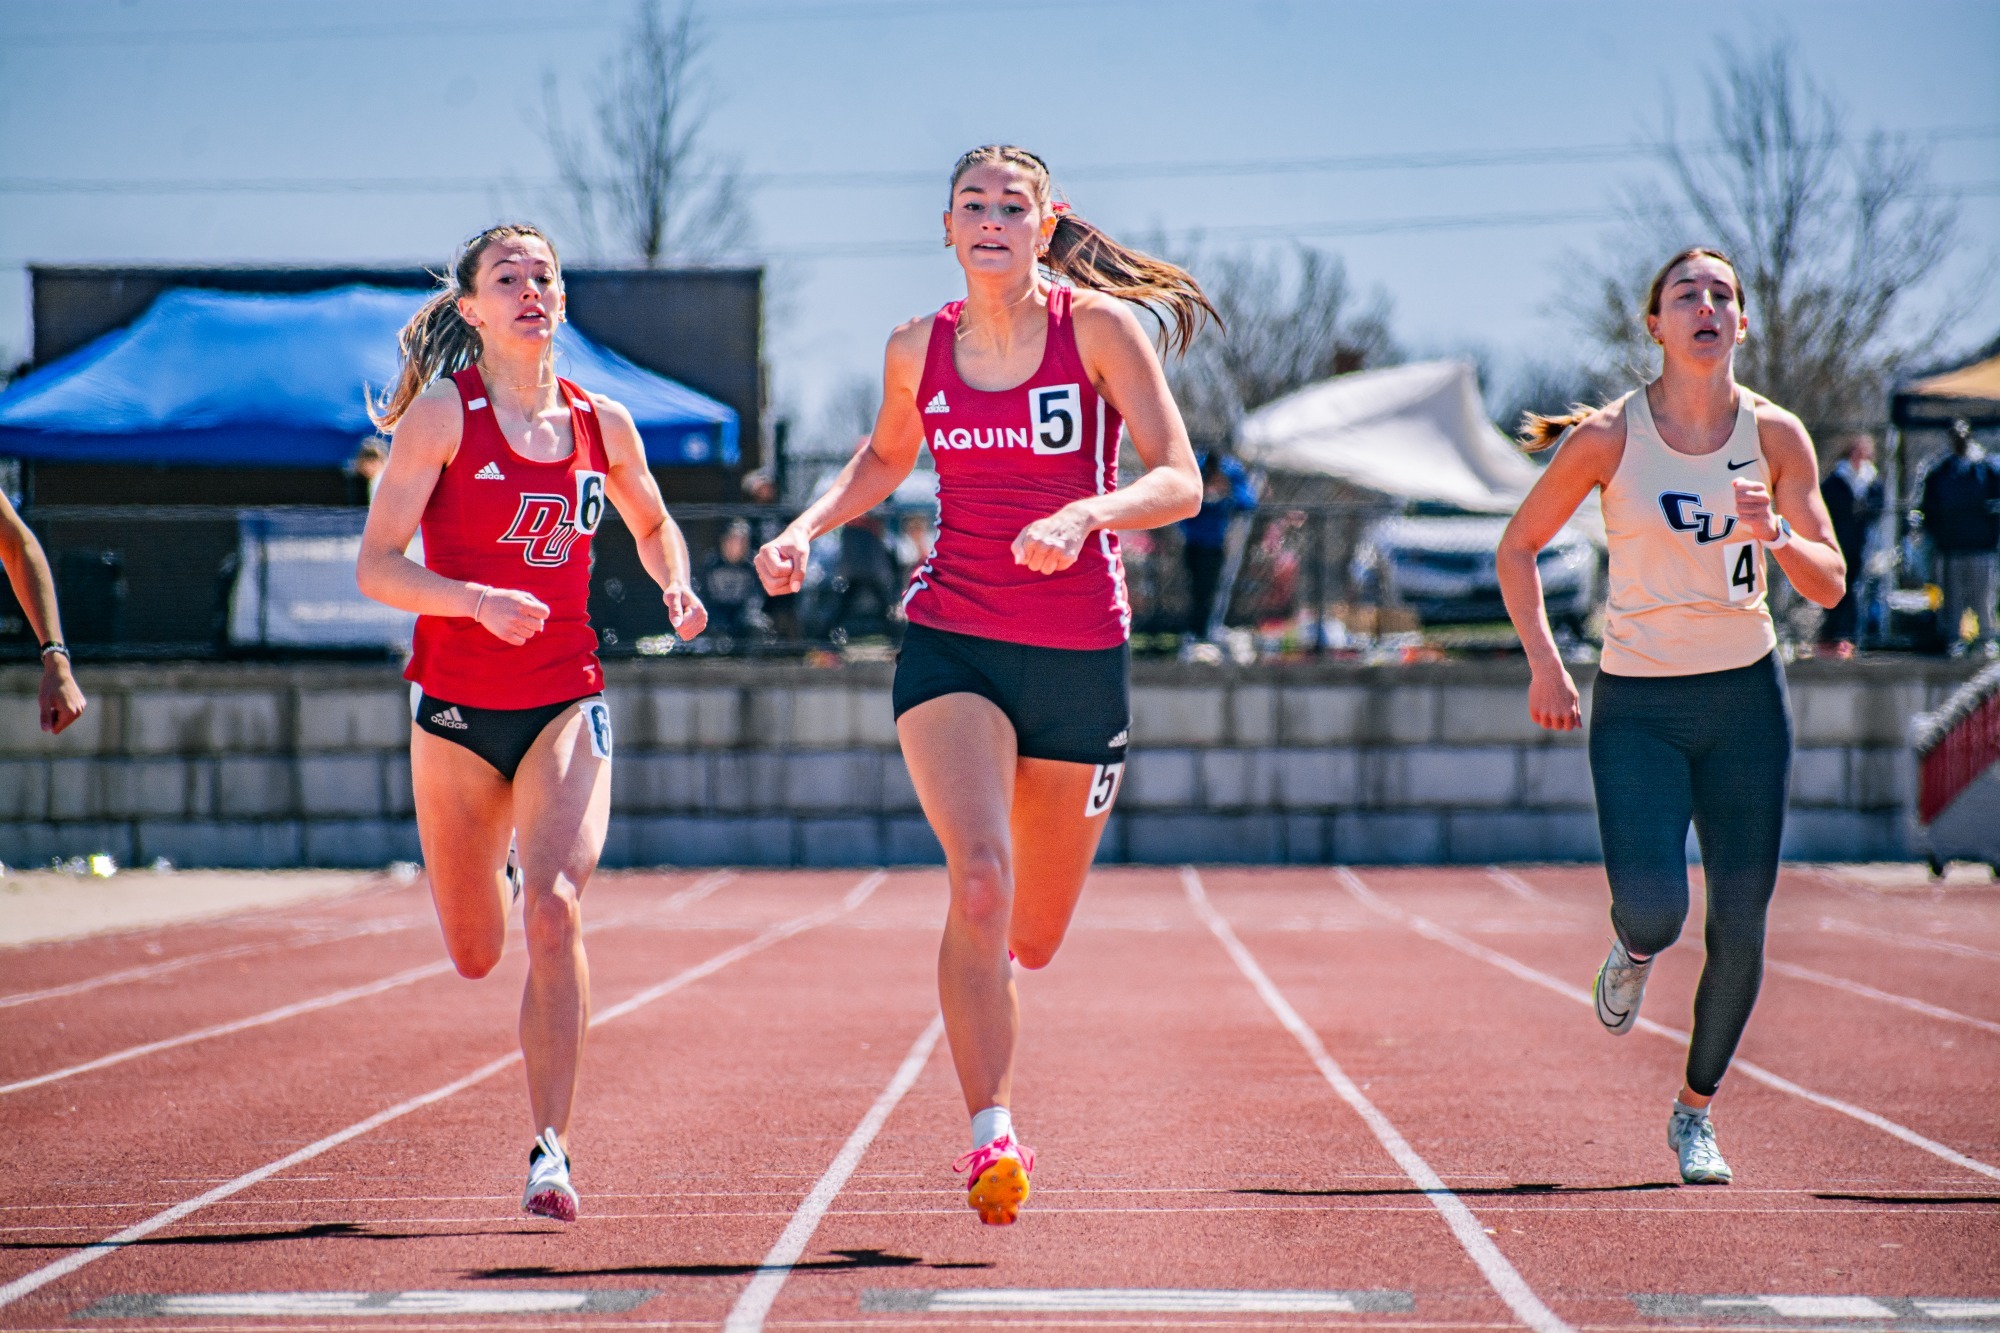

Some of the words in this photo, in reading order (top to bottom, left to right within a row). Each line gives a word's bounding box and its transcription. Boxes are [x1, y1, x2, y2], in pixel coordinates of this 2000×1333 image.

[933, 427, 1034, 450] AQUIN
[1038, 389, 1074, 449] 5
[474, 471, 506, 481] adidas
[580, 475, 602, 531] 6
[1732, 544, 1756, 593] 4
[430, 715, 469, 730] adidas
[591, 705, 610, 757] 6
[1094, 764, 1115, 809] 5
